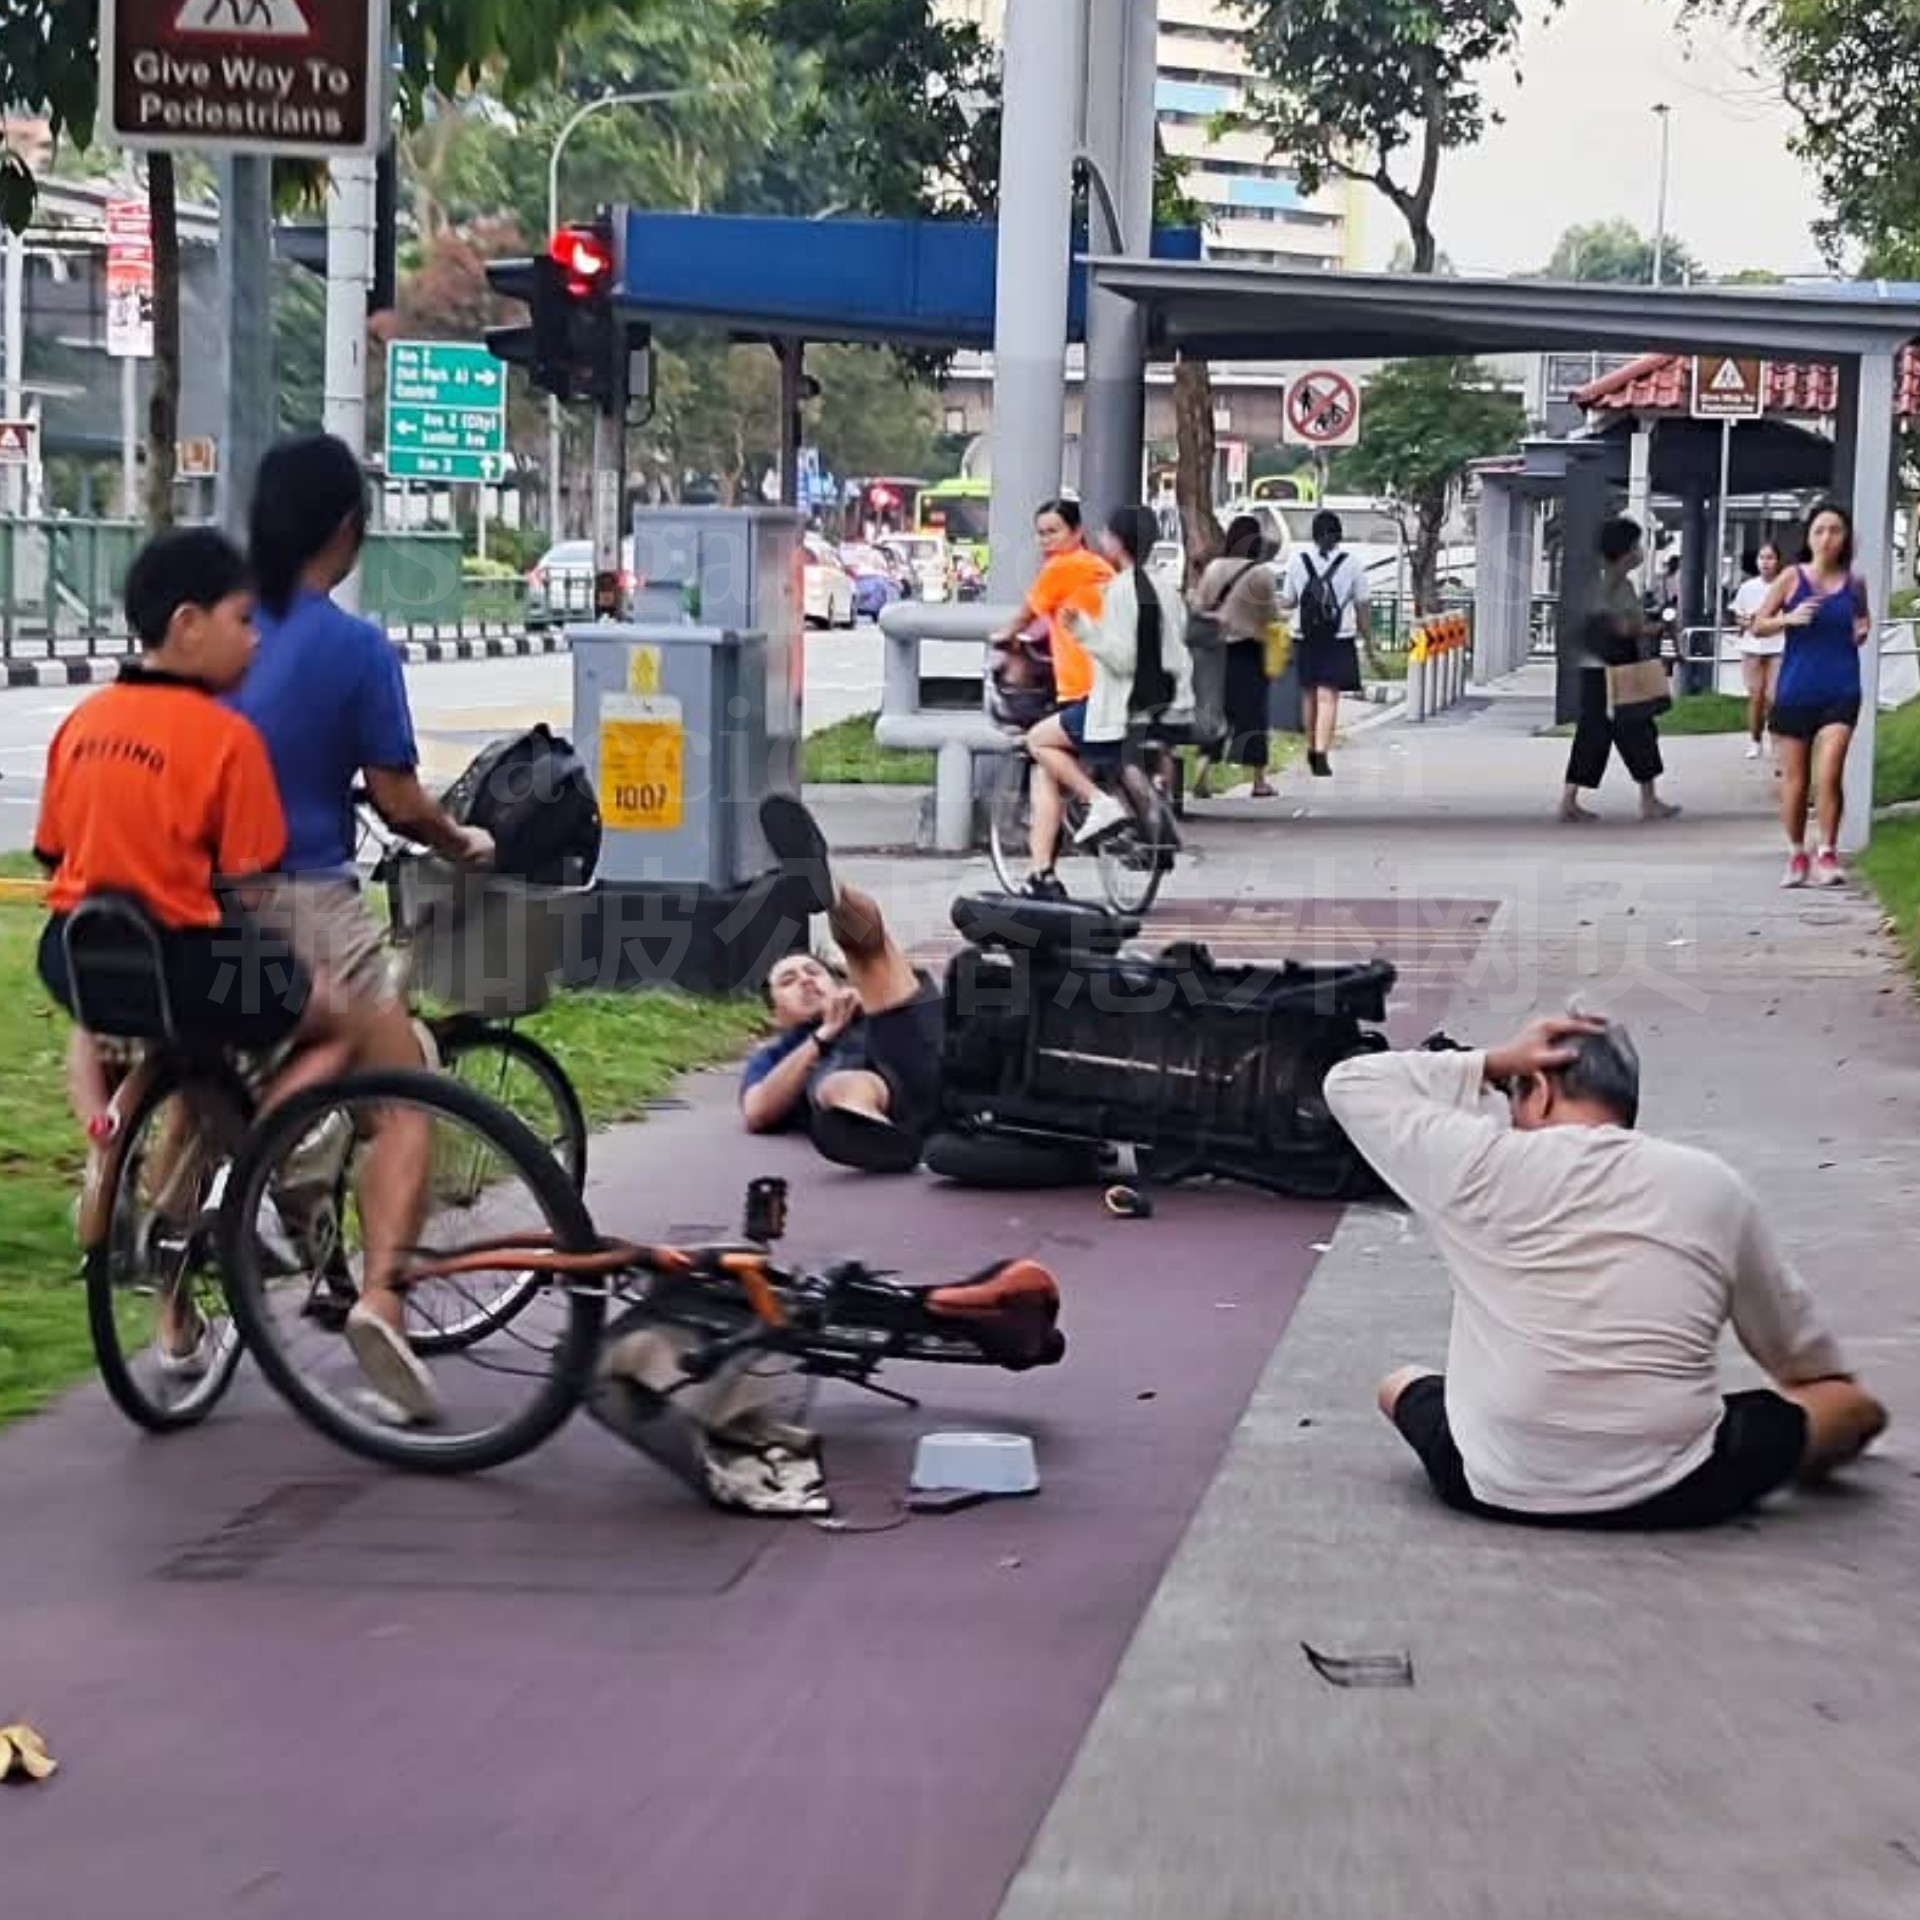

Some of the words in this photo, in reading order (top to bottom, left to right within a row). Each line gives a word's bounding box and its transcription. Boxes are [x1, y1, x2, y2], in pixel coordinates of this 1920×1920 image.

[133, 51, 211, 86] Give
[221, 56, 295, 97] Way
[306, 59, 350, 94] To
[139, 92, 343, 136] Pedestrians
